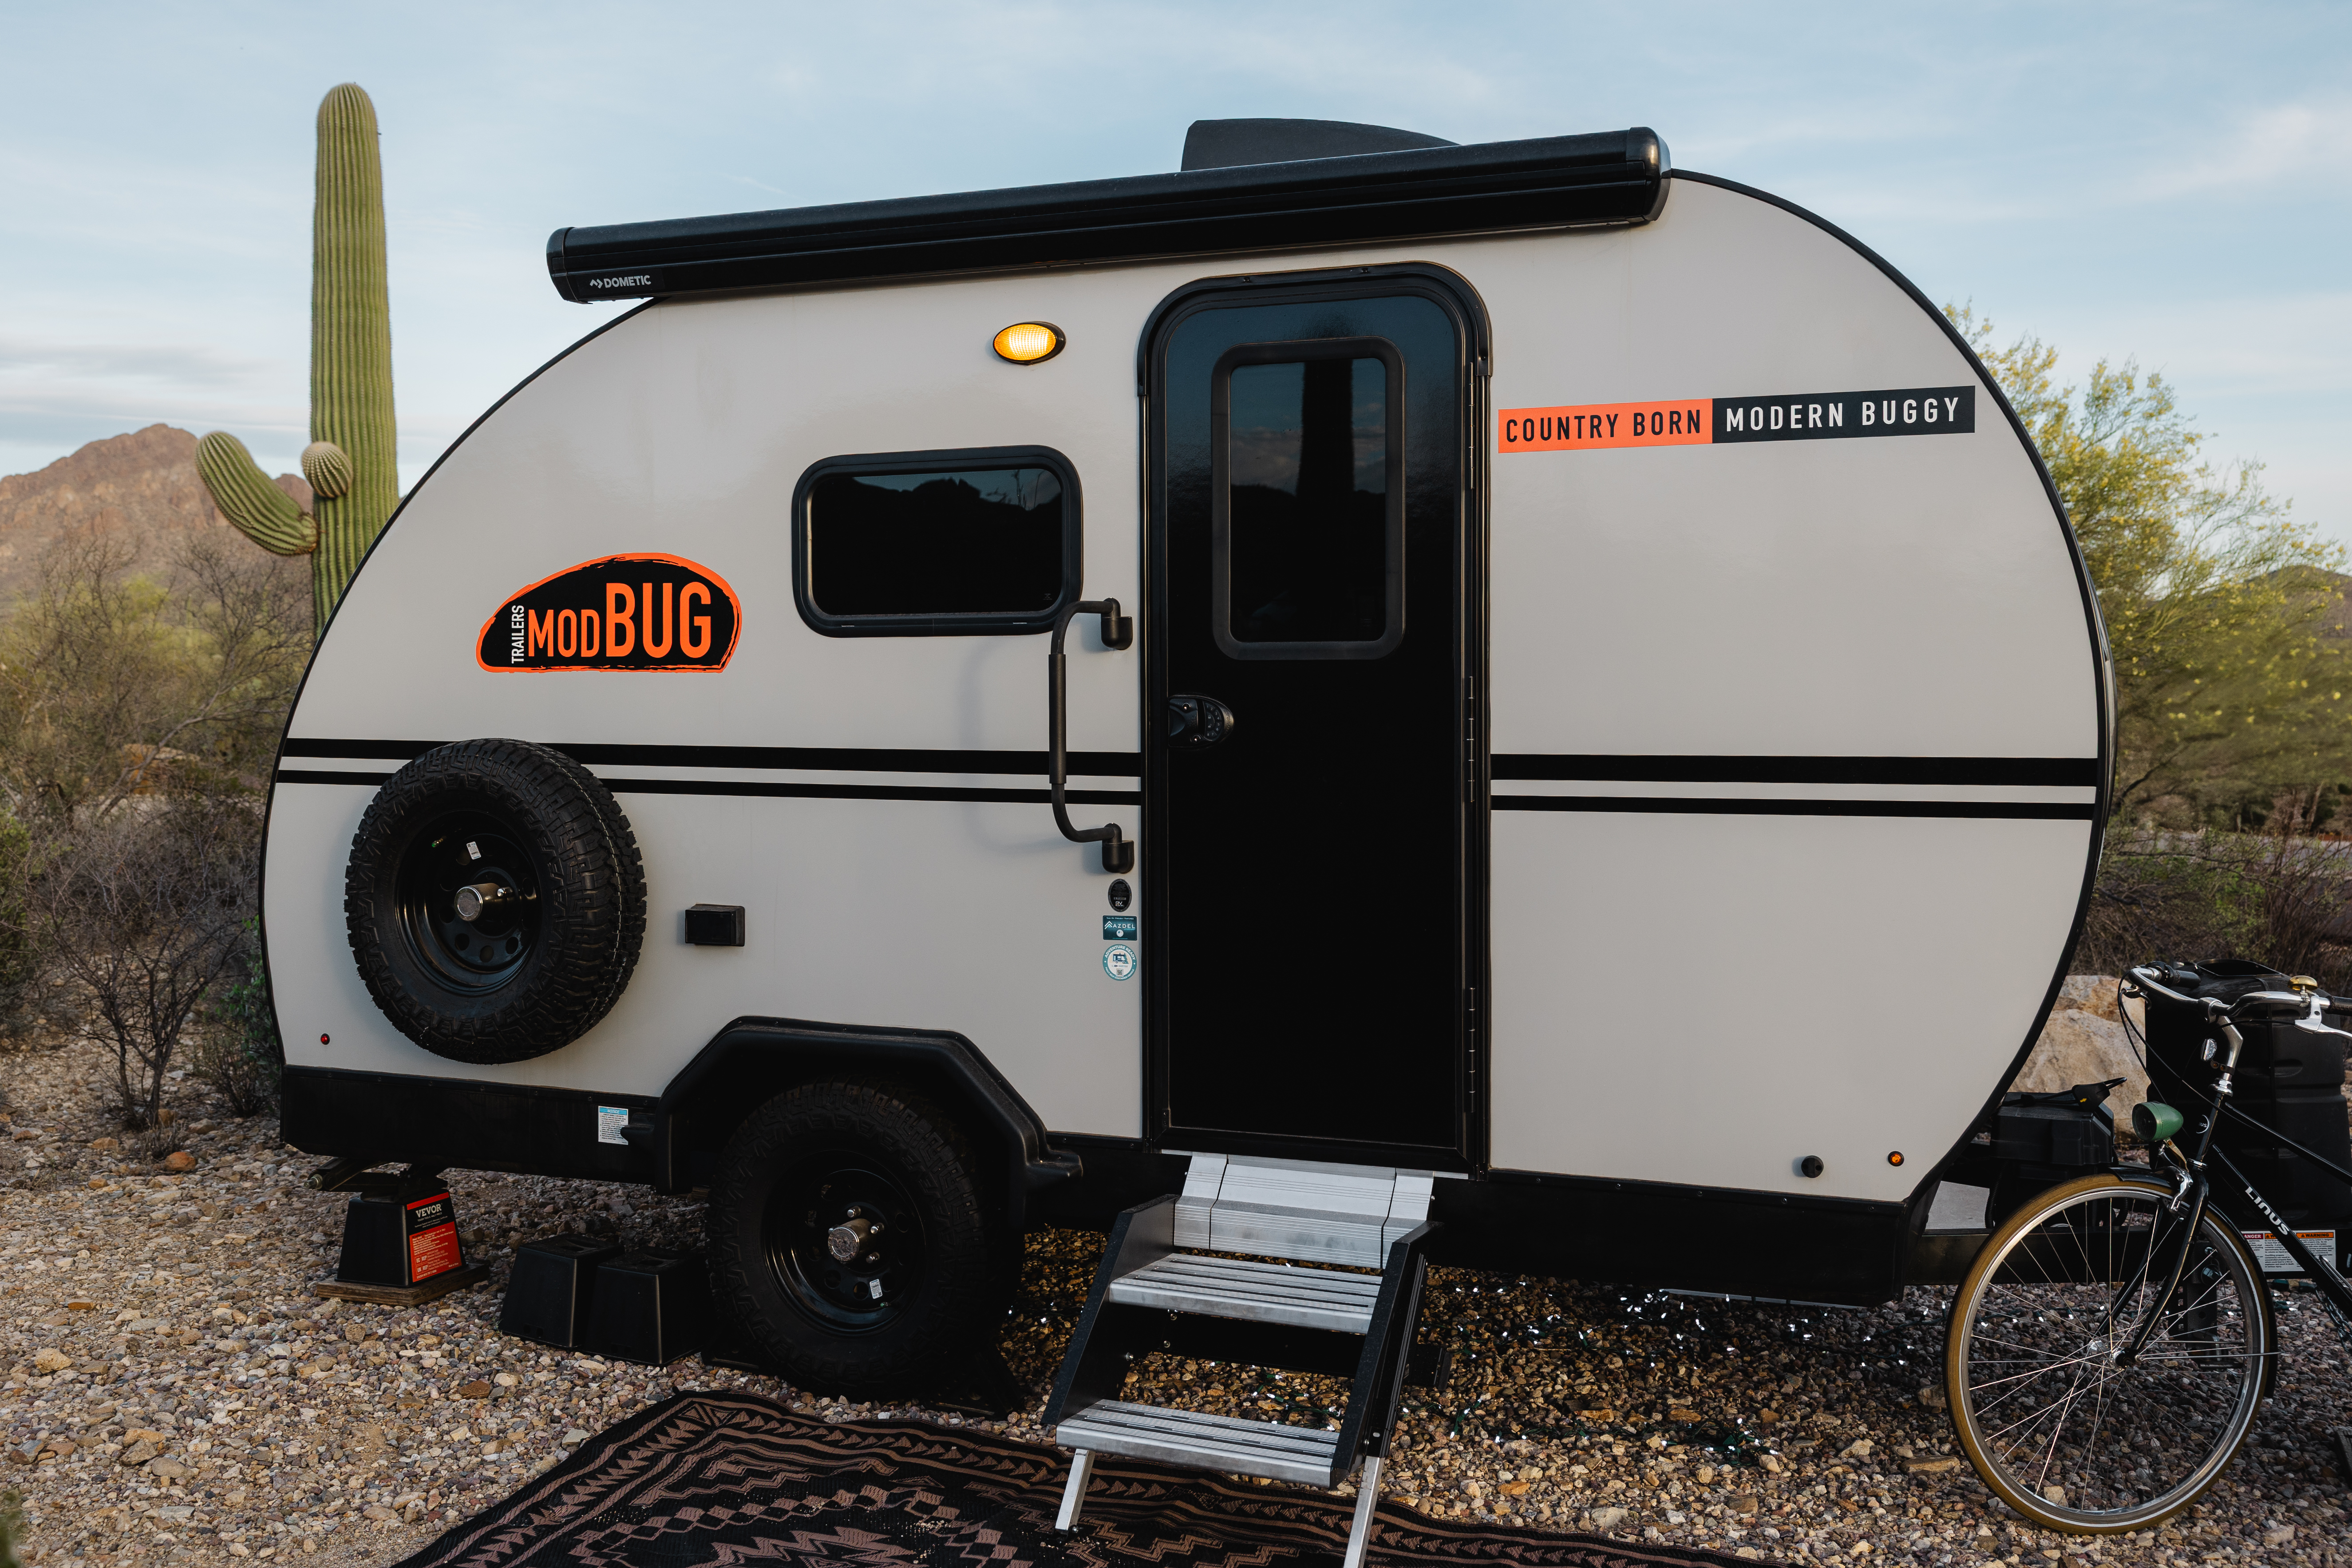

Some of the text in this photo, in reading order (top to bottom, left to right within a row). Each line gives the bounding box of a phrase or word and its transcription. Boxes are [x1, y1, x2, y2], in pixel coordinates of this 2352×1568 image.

[604, 275, 651, 288] DOMETIC
[1506, 397, 1959, 442] COUNTRY BORN MODERN BUGGY
[511, 605, 524, 664] TRAILERS
[1105, 945, 1136, 960] ADVENTURE READY
[415, 1204, 442, 1218] VEVOR
